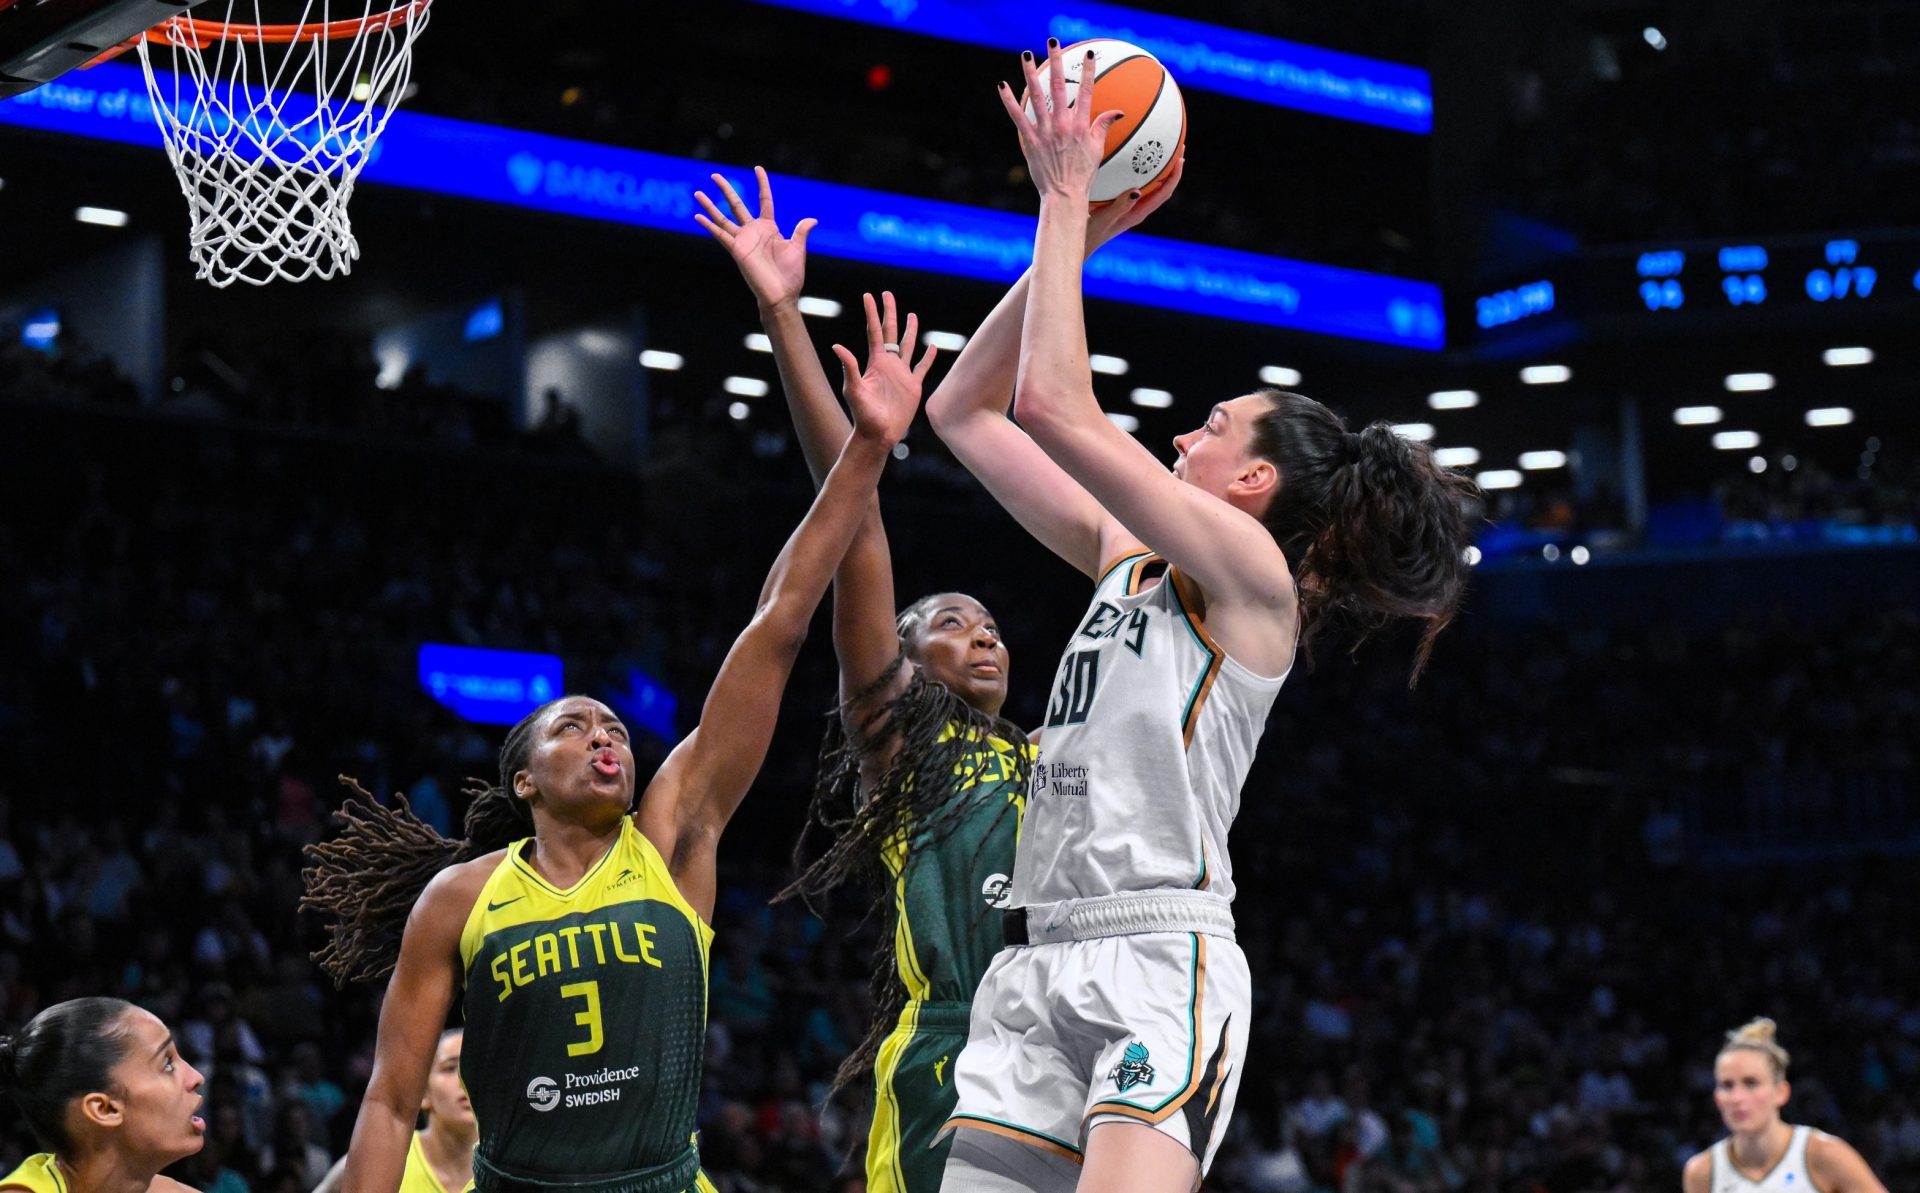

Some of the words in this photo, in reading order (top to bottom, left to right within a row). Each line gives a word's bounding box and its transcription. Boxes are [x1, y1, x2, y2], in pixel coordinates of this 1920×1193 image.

[1046, 649, 1100, 729] 30
[1050, 762, 1090, 781] Liberty
[606, 873, 643, 891] SYMETRA
[490, 921, 662, 1003] SEATTLE
[560, 980, 605, 1057] 3
[564, 1066, 640, 1089] Providence
[564, 1087, 621, 1108] SWEDISH
